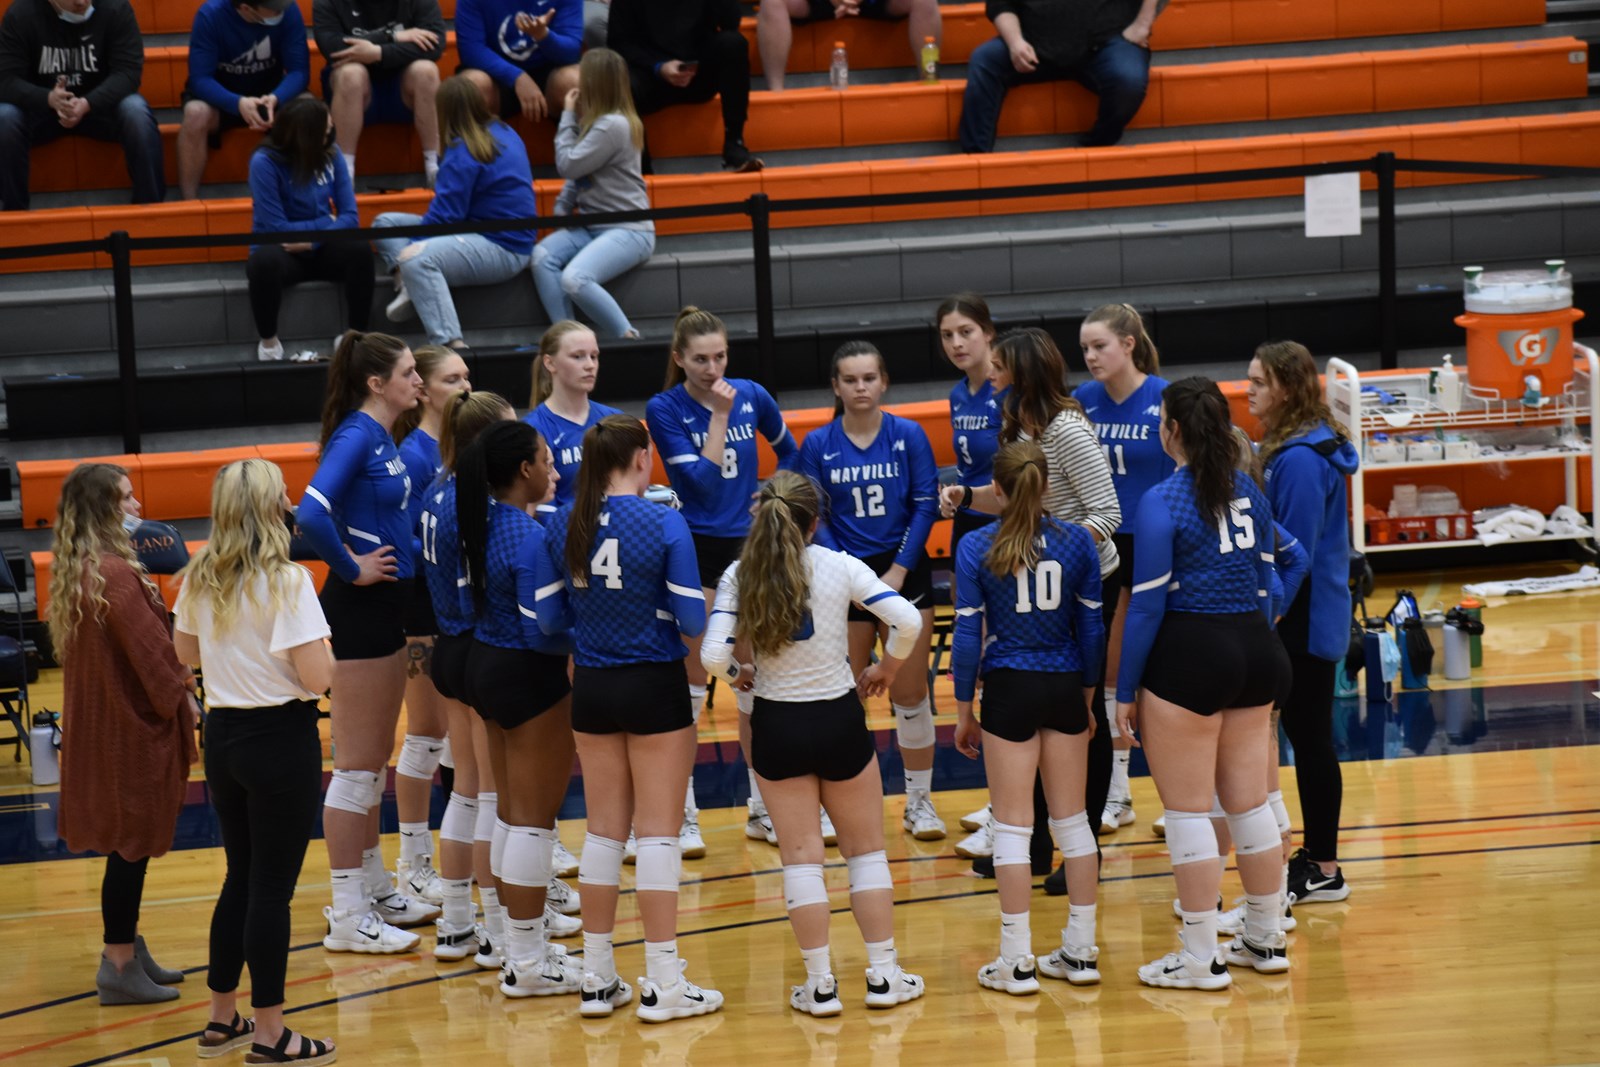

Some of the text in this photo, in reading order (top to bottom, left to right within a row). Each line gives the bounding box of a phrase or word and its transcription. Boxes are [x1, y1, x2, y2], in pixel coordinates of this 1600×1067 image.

[1519, 334, 1541, 358] G
[721, 447, 738, 479] 8
[958, 435, 972, 465] 3
[830, 461, 900, 485] MAYVILLE
[851, 484, 886, 518] 12
[1214, 497, 1256, 555] 15
[1015, 560, 1062, 613] 10
